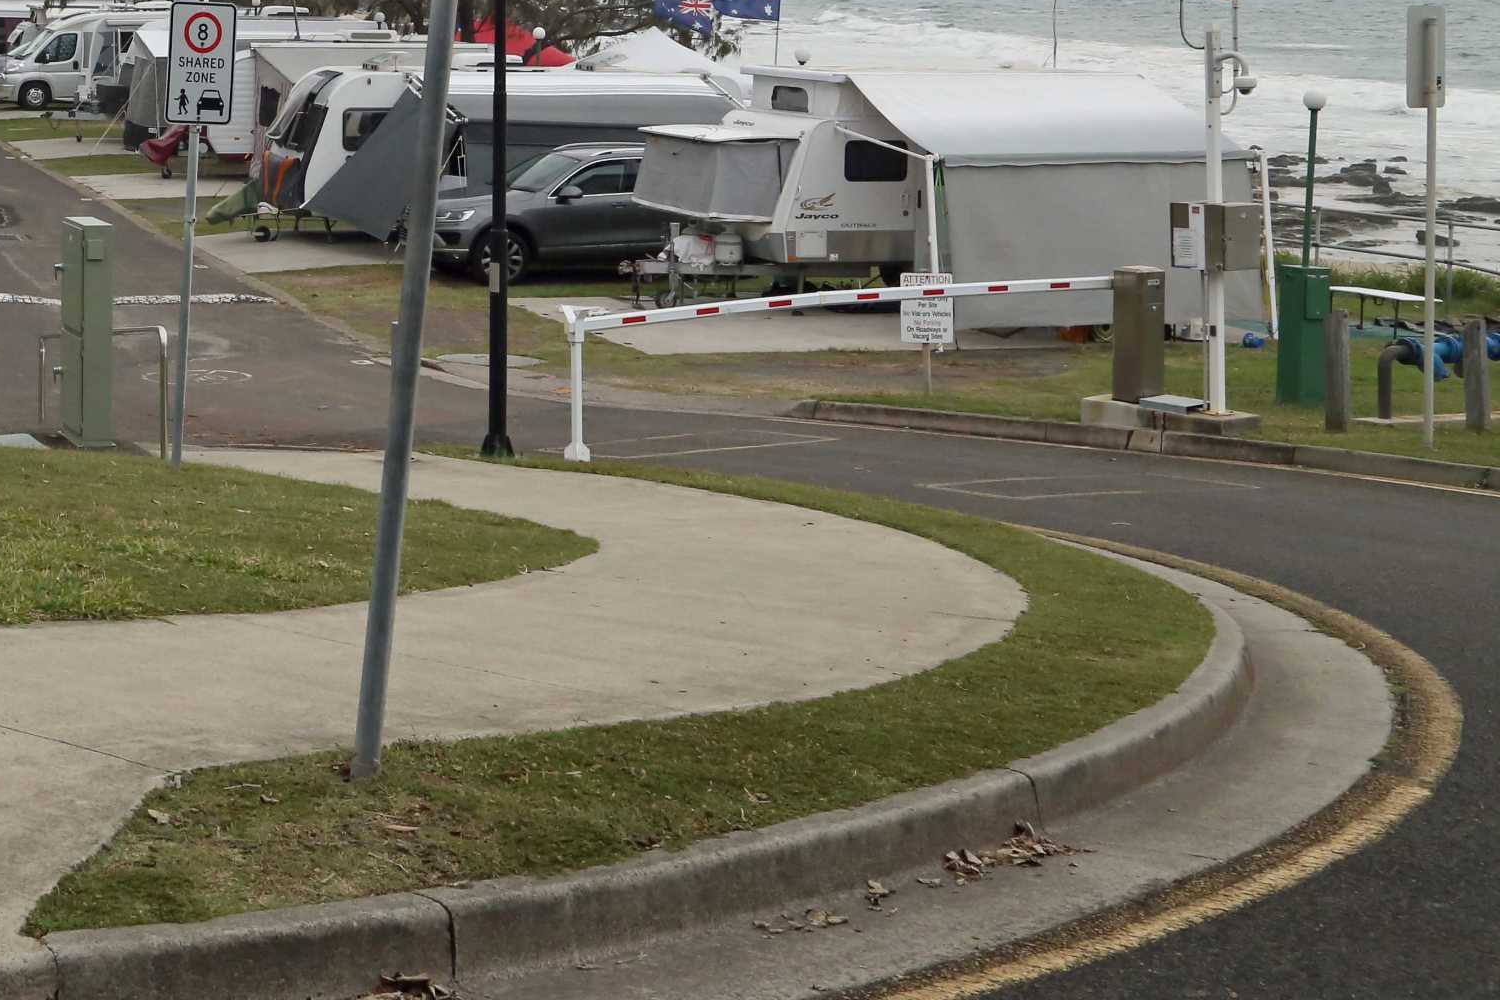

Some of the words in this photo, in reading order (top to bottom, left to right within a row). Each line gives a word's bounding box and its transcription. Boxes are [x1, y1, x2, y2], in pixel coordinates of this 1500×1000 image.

[198, 24, 208, 40] 8
[178, 56, 225, 69] SHARED
[185, 71, 216, 83] ZONE
[795, 212, 840, 220] Jayco
[904, 275, 950, 284] ATTENTION
